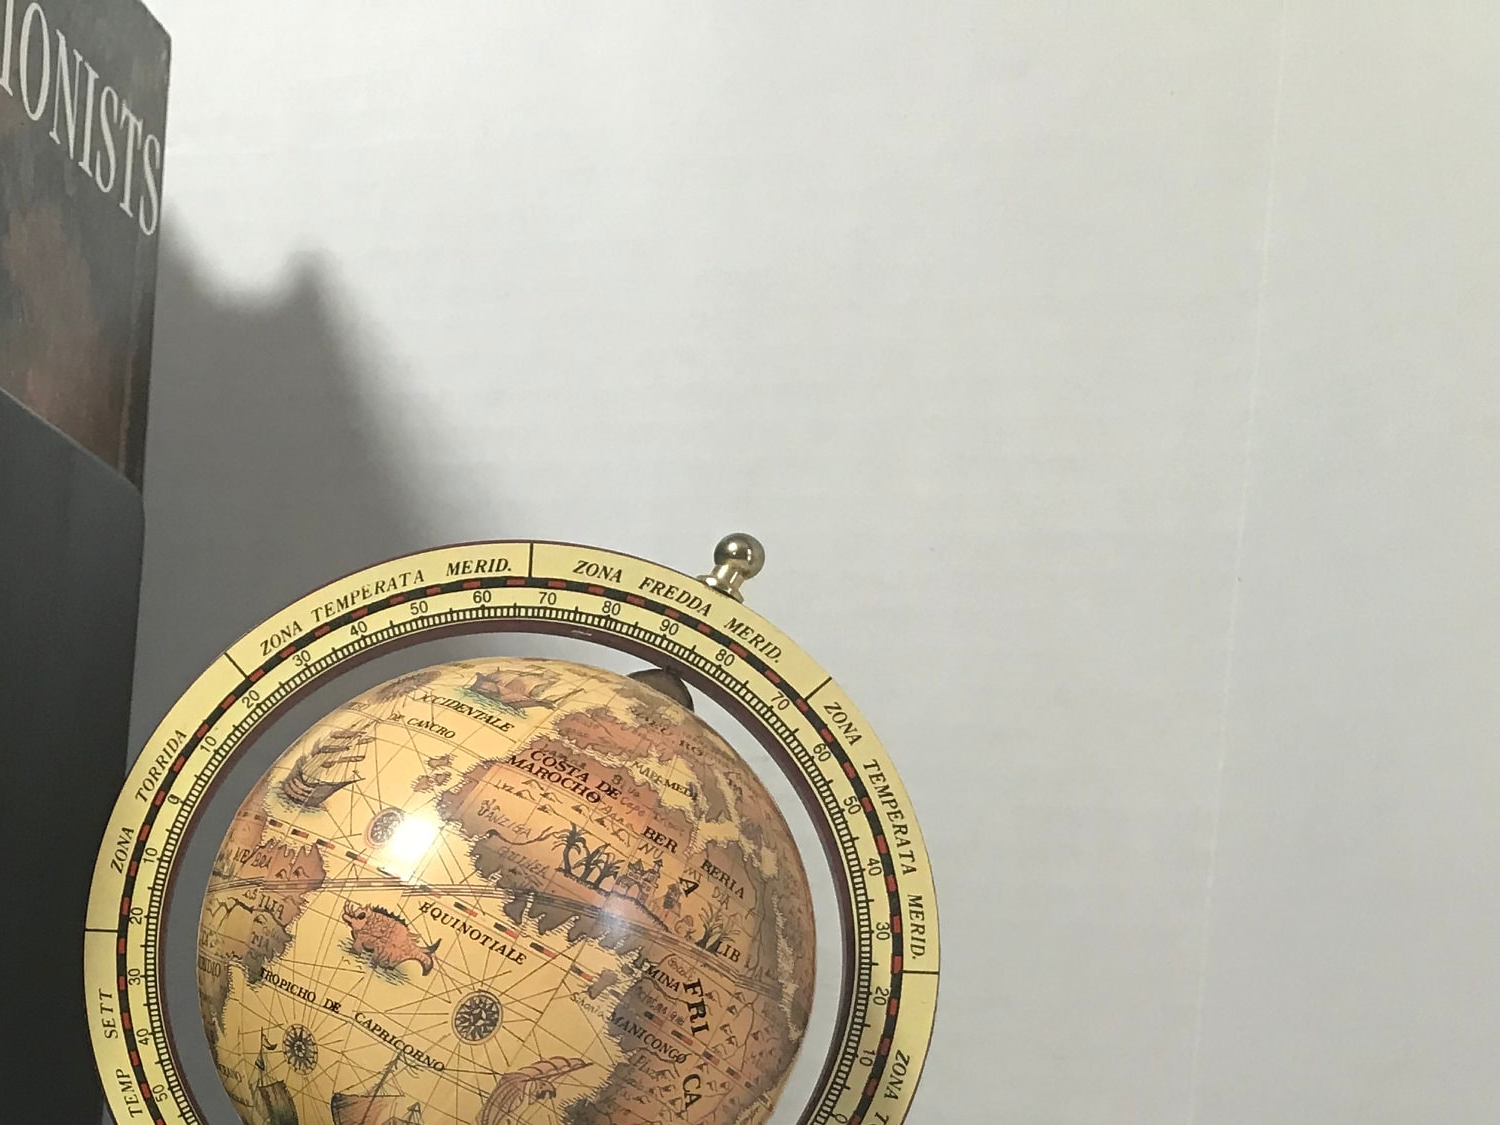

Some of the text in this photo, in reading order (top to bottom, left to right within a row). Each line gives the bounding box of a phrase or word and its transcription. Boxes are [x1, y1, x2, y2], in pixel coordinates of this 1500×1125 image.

[473, 590, 492, 604] 60
[538, 592, 558, 606] 70
[259, 557, 513, 657] ZONA TEMPERATA MERID.
[410, 600, 429, 616] 50
[572, 560, 782, 664] ZONA FREDDA MERID.
[601, 601, 621, 616] 80
[349, 620, 368, 637] 40
[659, 619, 679, 636] 90
[292, 649, 312, 667] 30
[715, 648, 735, 667] 80
[241, 689, 261, 709] 20
[770, 691, 790, 710] 70
[407, 716, 457, 739] CANCRO
[200, 735, 217, 753] 10
[813, 742, 831, 762] 60
[507, 755, 600, 804] MAROCHO
[530, 749, 590, 783] COSTA
[595, 780, 623, 801] DE
[110, 729, 187, 874] ZONA TORRIDA
[843, 795, 861, 815] 50
[642, 825, 679, 853] BER
[823, 702, 926, 960] ZONA TEMPERATA MERID.
[143, 847, 158, 865] 10
[867, 857, 882, 876] 40
[700, 858, 745, 899] BERIA
[130, 907, 144, 925] 20
[418, 901, 527, 965] EQUINOTIALE
[875, 921, 890, 940] 30
[128, 967, 141, 985] 30
[873, 986, 889, 1006] 20
[98, 987, 118, 1039] SETT
[260, 967, 317, 1004] TROPICHO
[324, 998, 342, 1014] DE
[354, 1011, 446, 1072] CAPRICORNO
[137, 1028, 150, 1046] 40
[859, 1049, 876, 1067] 10
[884, 1049, 910, 1101] ZONA
[116, 1067, 143, 1119] TEMP
[152, 1084, 168, 1102] 50
